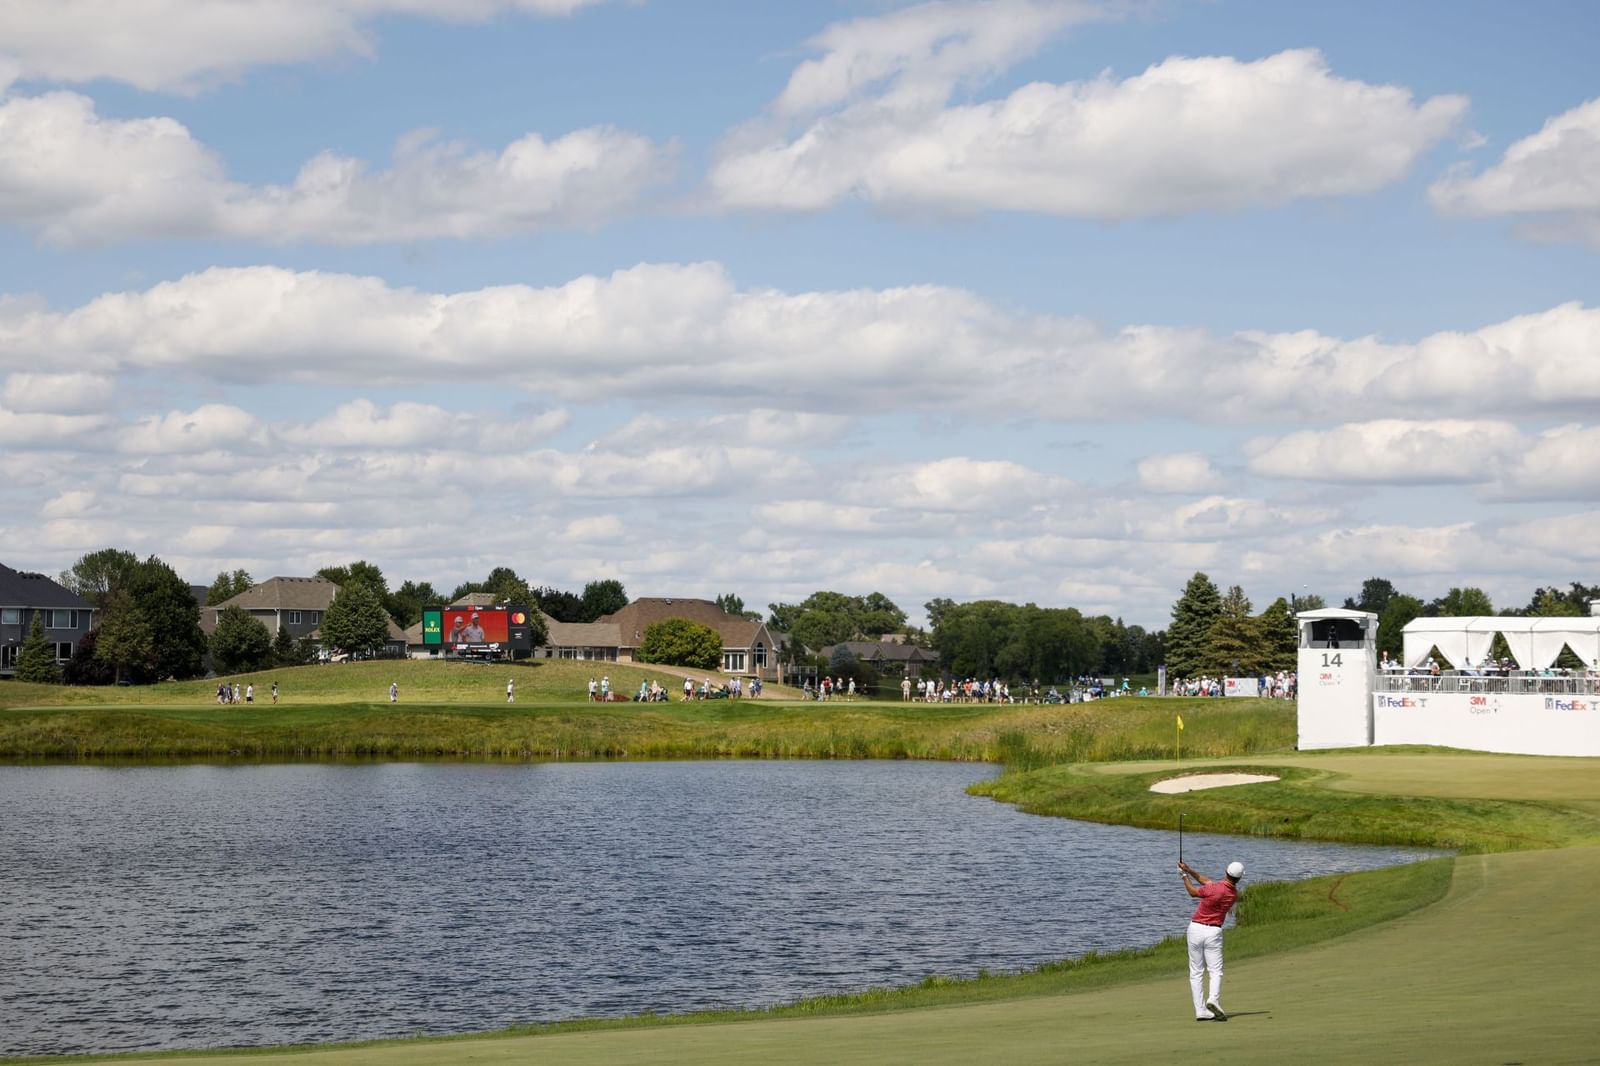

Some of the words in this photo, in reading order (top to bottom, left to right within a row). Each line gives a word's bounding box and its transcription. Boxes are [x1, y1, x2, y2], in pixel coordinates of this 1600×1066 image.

[1321, 653, 1343, 667] 14
[1387, 697, 1416, 707] FedEx
[1470, 696, 1487, 705] 3M
[1555, 700, 1587, 710] FedEx
